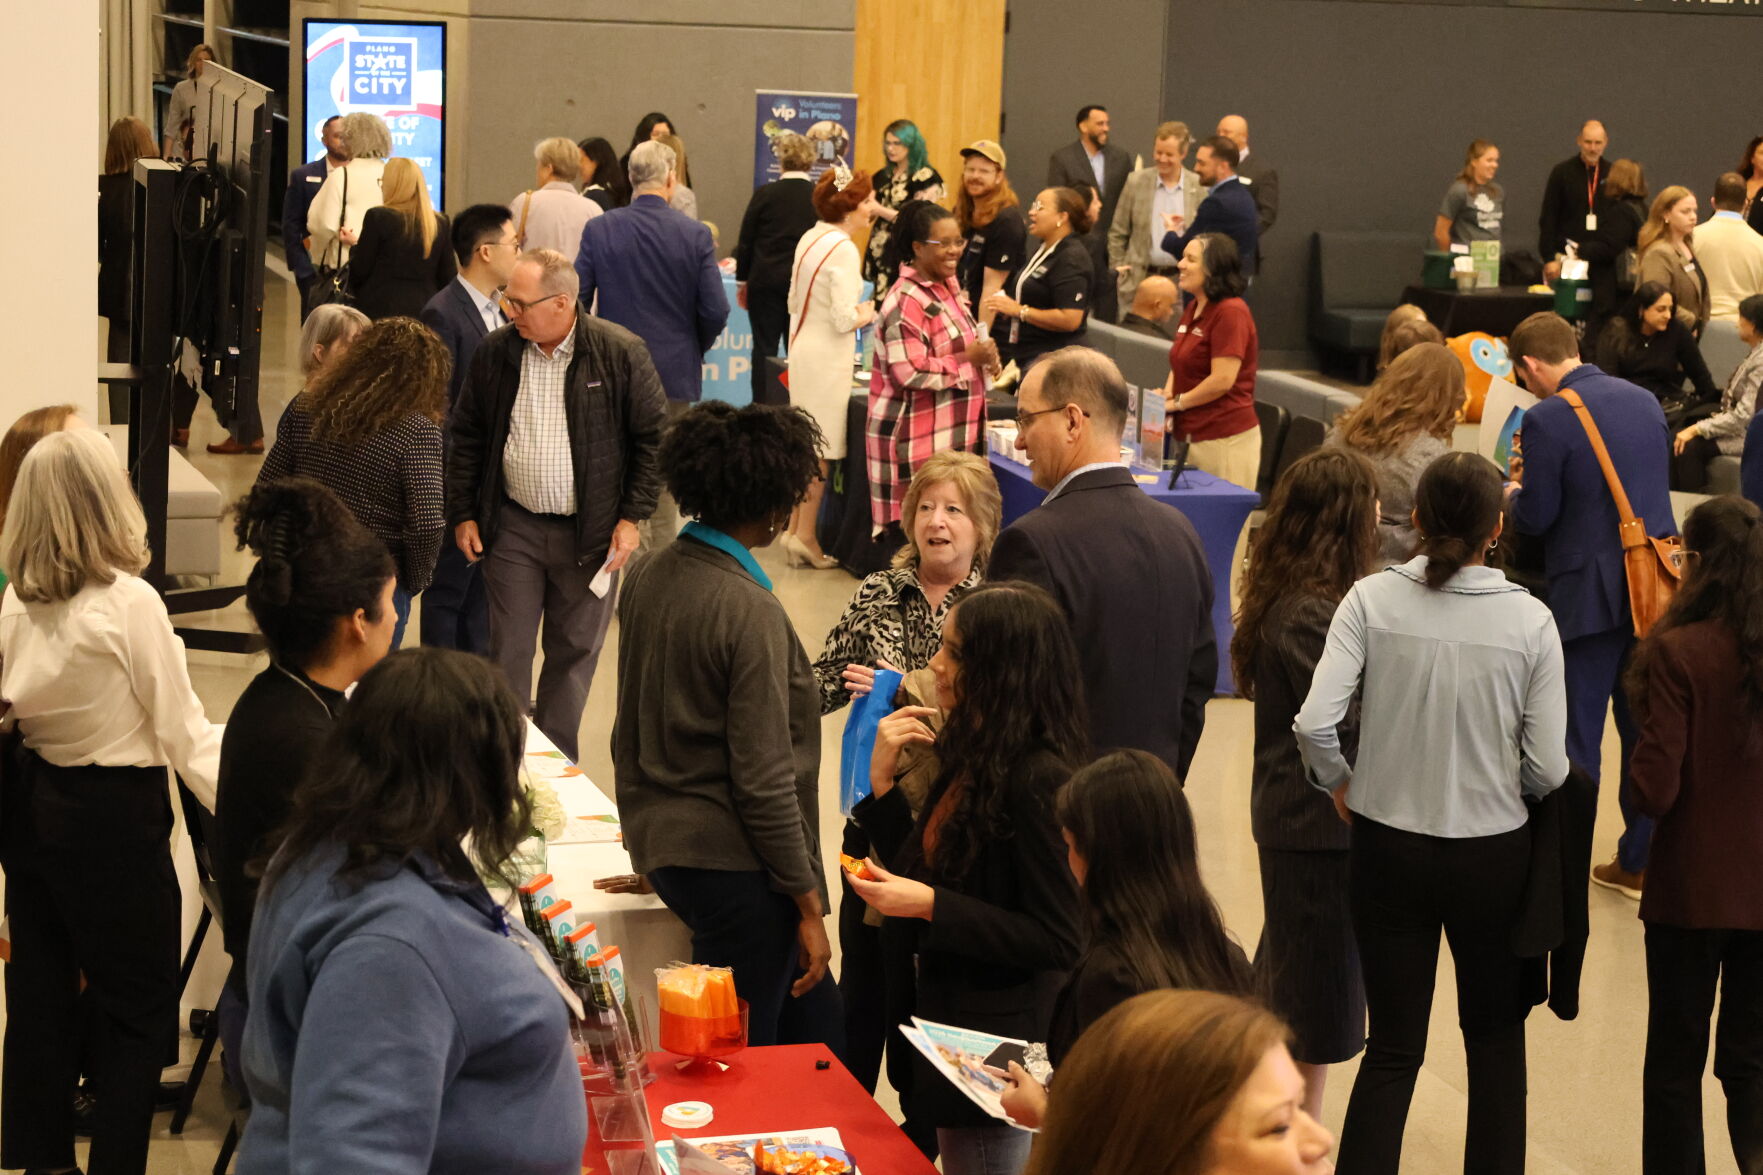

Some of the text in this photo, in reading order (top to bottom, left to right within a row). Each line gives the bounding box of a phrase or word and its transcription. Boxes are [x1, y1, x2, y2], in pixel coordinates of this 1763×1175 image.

[366, 45, 396, 53] PLANO
[354, 77, 407, 95] CITY
[771, 104, 797, 121] vip
[798, 108, 842, 121] in Plano
[398, 116, 420, 130] OF
[391, 132, 416, 146] ITY
[702, 363, 719, 381] n
